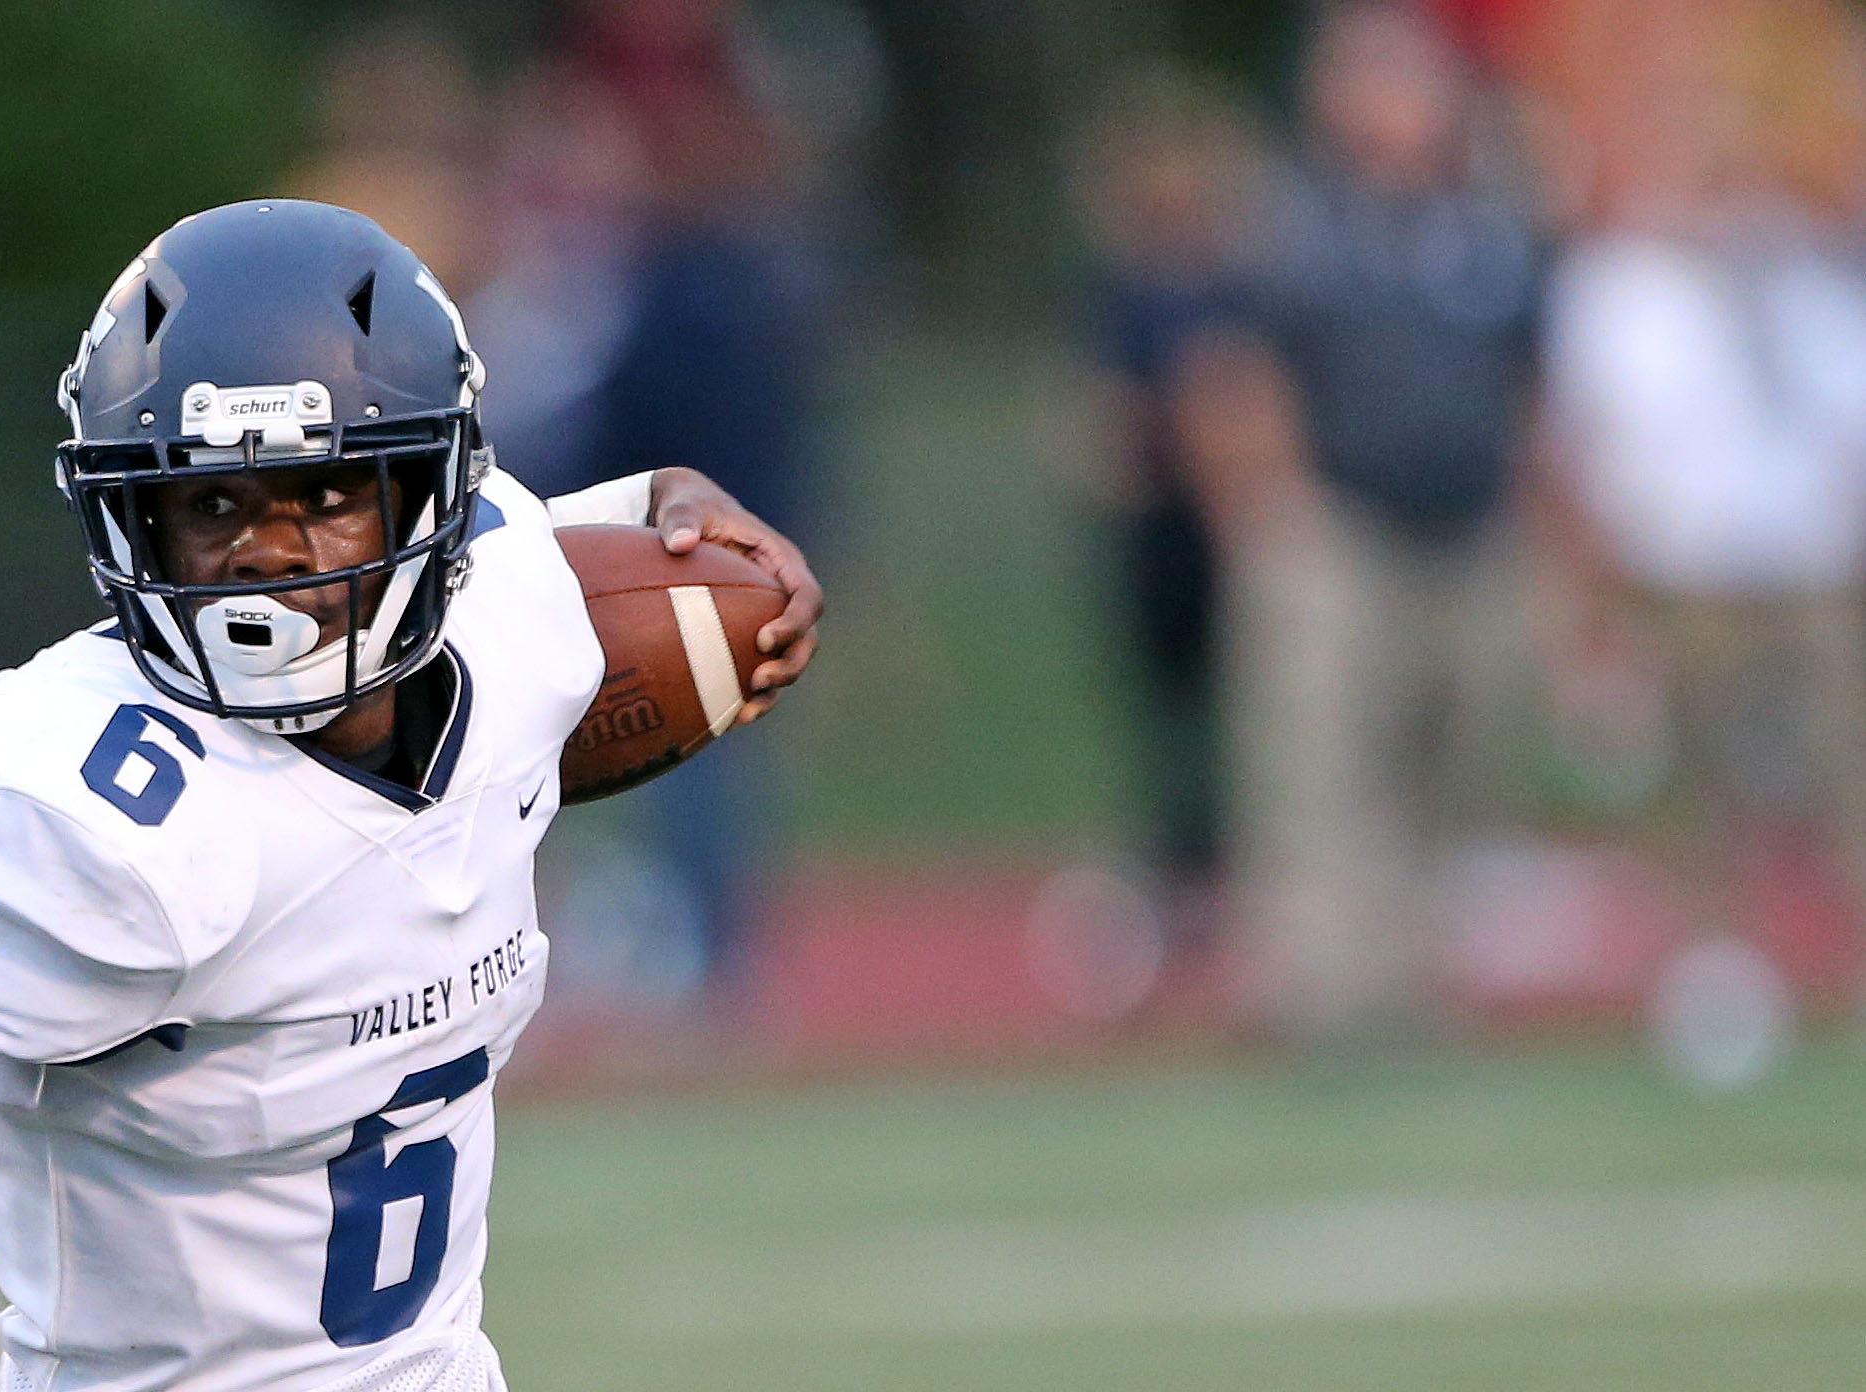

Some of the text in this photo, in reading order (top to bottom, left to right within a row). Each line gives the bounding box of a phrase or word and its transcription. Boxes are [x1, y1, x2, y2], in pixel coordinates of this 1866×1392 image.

[228, 399, 288, 416] schutt
[224, 608, 274, 621] SHOCK
[80, 704, 206, 827] 6
[350, 928, 526, 1046] VALLEY FORGE
[320, 1046, 490, 1348] 6
